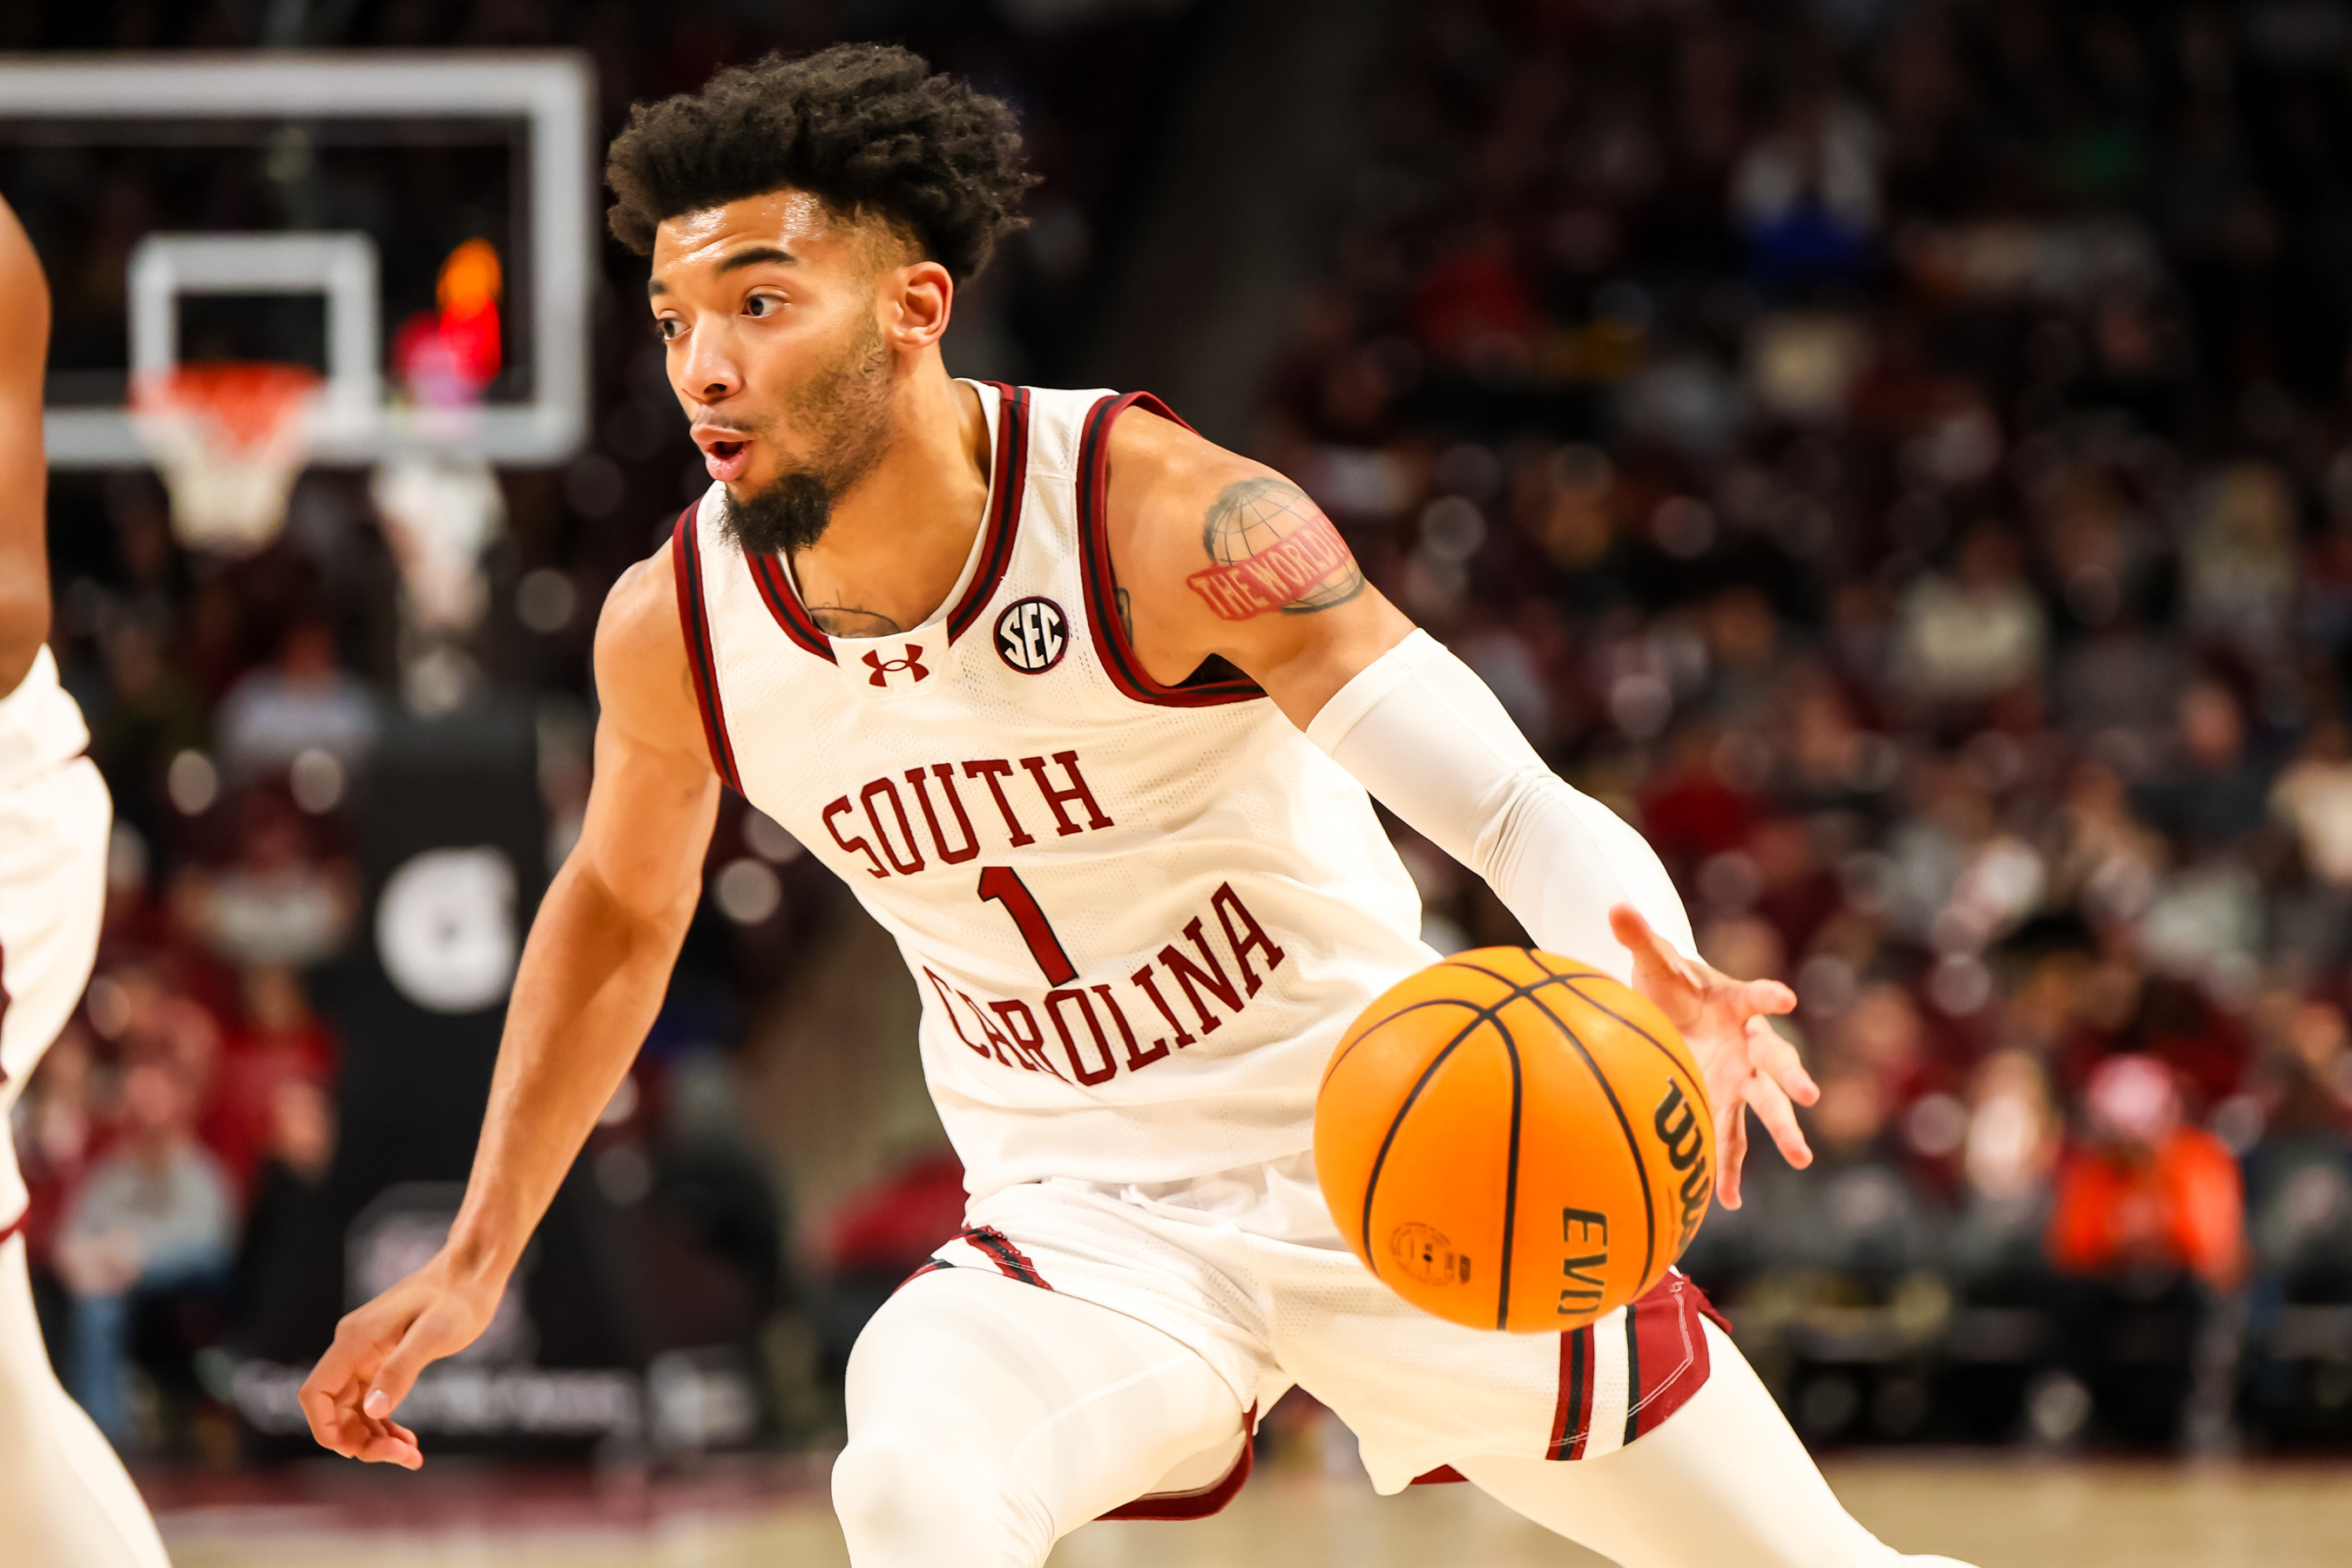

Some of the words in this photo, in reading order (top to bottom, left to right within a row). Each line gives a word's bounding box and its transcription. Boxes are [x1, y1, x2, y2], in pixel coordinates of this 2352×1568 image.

[1190, 568, 1270, 617] THE
[1246, 526, 1338, 602] WORLD
[1000, 601, 1063, 669] SEC
[821, 749, 1115, 879] SOUTH
[922, 881, 1286, 1087] CAROLINA
[977, 865, 1080, 989] 1
